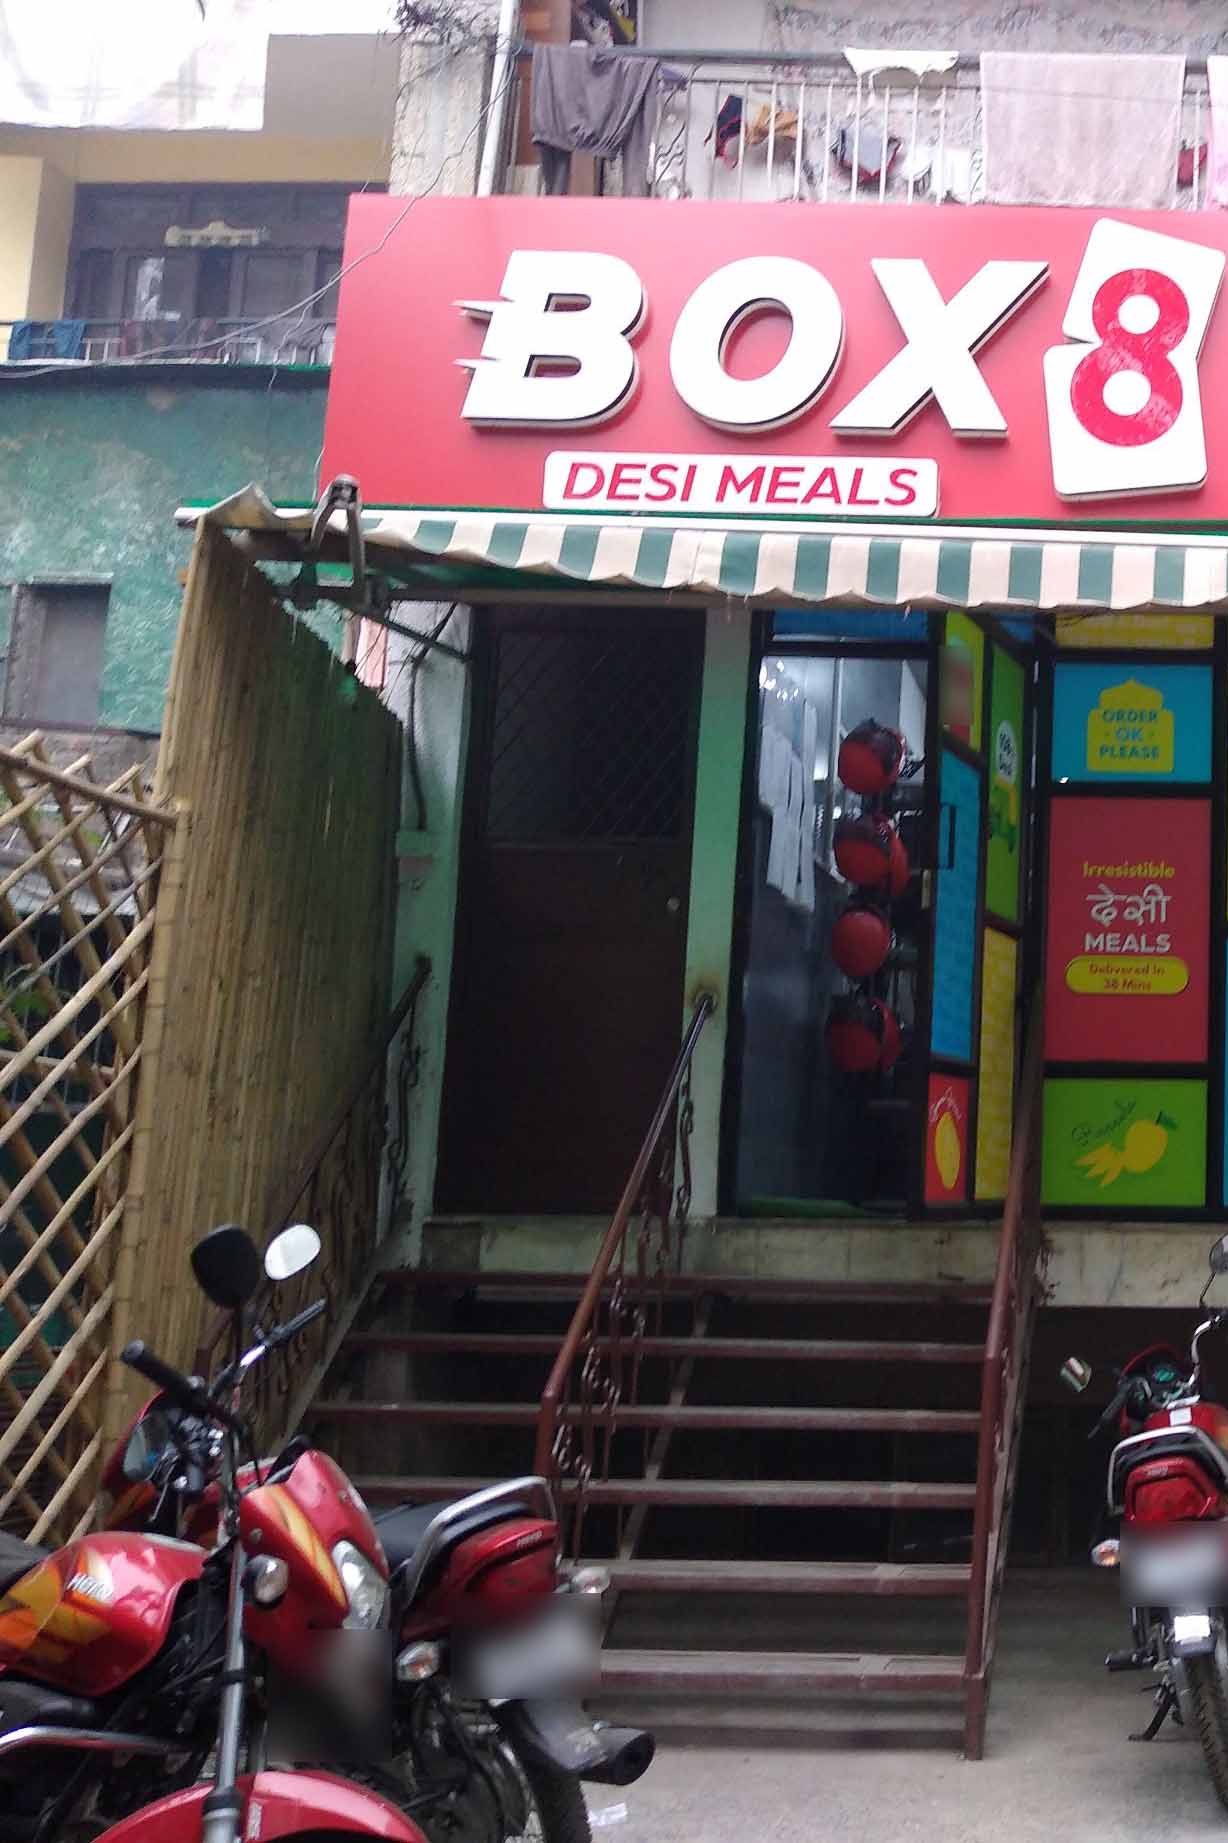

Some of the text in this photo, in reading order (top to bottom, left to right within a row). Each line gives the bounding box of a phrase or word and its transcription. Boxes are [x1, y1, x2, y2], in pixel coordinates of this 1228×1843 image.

[562, 462, 918, 507] DESI MEALS
[1102, 709, 1159, 722] ORDER
[1099, 745, 1160, 760] PLEASE
[1083, 861, 1175, 879] Irresistible
[1086, 883, 1172, 927] देसी
[1084, 933, 1171, 953] MEALS
